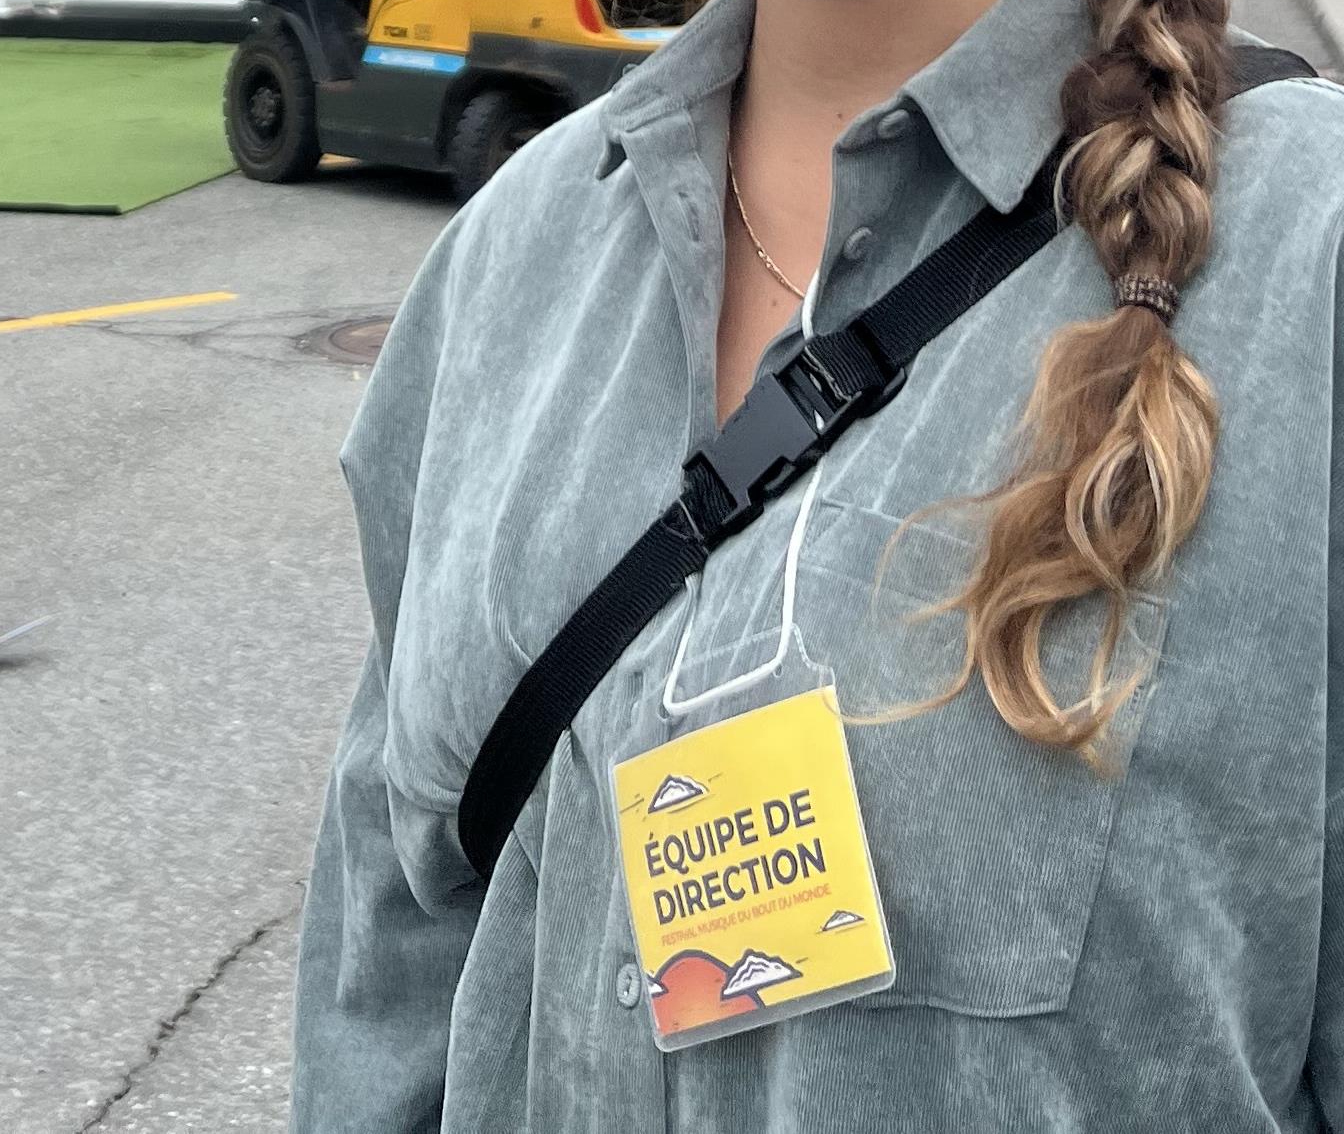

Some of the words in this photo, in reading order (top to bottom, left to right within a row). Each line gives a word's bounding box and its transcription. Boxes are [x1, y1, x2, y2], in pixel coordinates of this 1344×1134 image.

[645, 808, 759, 878] ÉQUIPE
[763, 789, 816, 838] DE
[653, 837, 826, 926] DIRECTION
[661, 928, 698, 947] FESTIVAL
[697, 913, 738, 937] MUSIQUE
[738, 907, 751, 923] DU
[751, 900, 777, 919] BOUT
[777, 895, 793, 913] DU
[794, 885, 832, 905] MONDE
